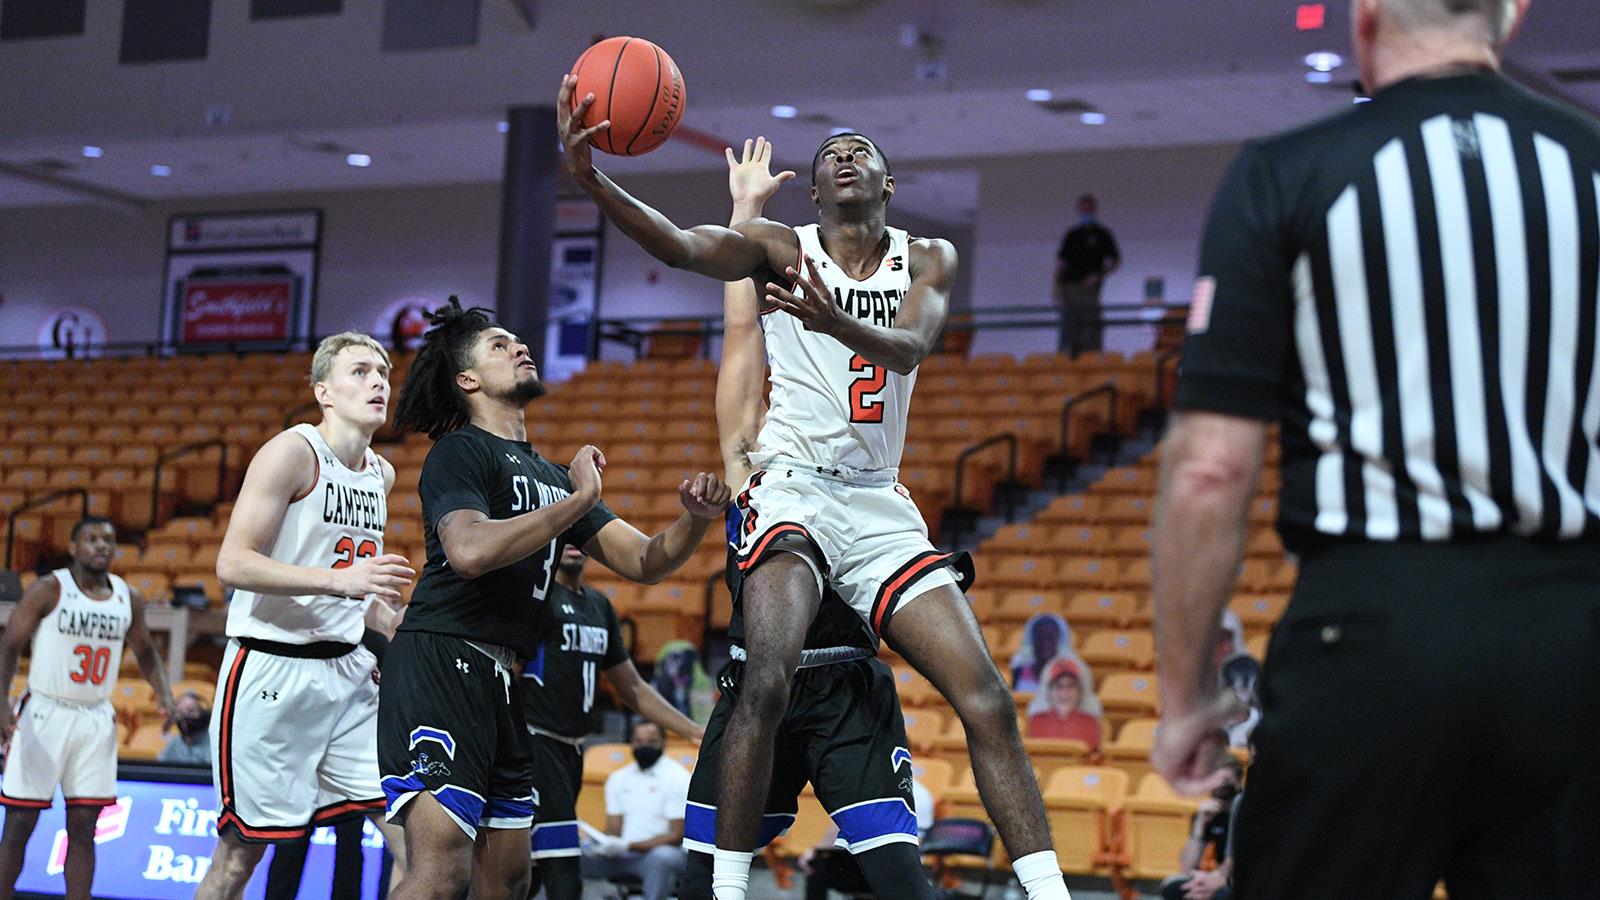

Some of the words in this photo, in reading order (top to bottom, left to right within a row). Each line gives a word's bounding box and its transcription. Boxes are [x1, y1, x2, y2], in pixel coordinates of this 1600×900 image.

[848, 353, 887, 424] 2
[532, 537, 557, 601] 3
[69, 643, 111, 685] 30
[582, 660, 596, 713] 11
